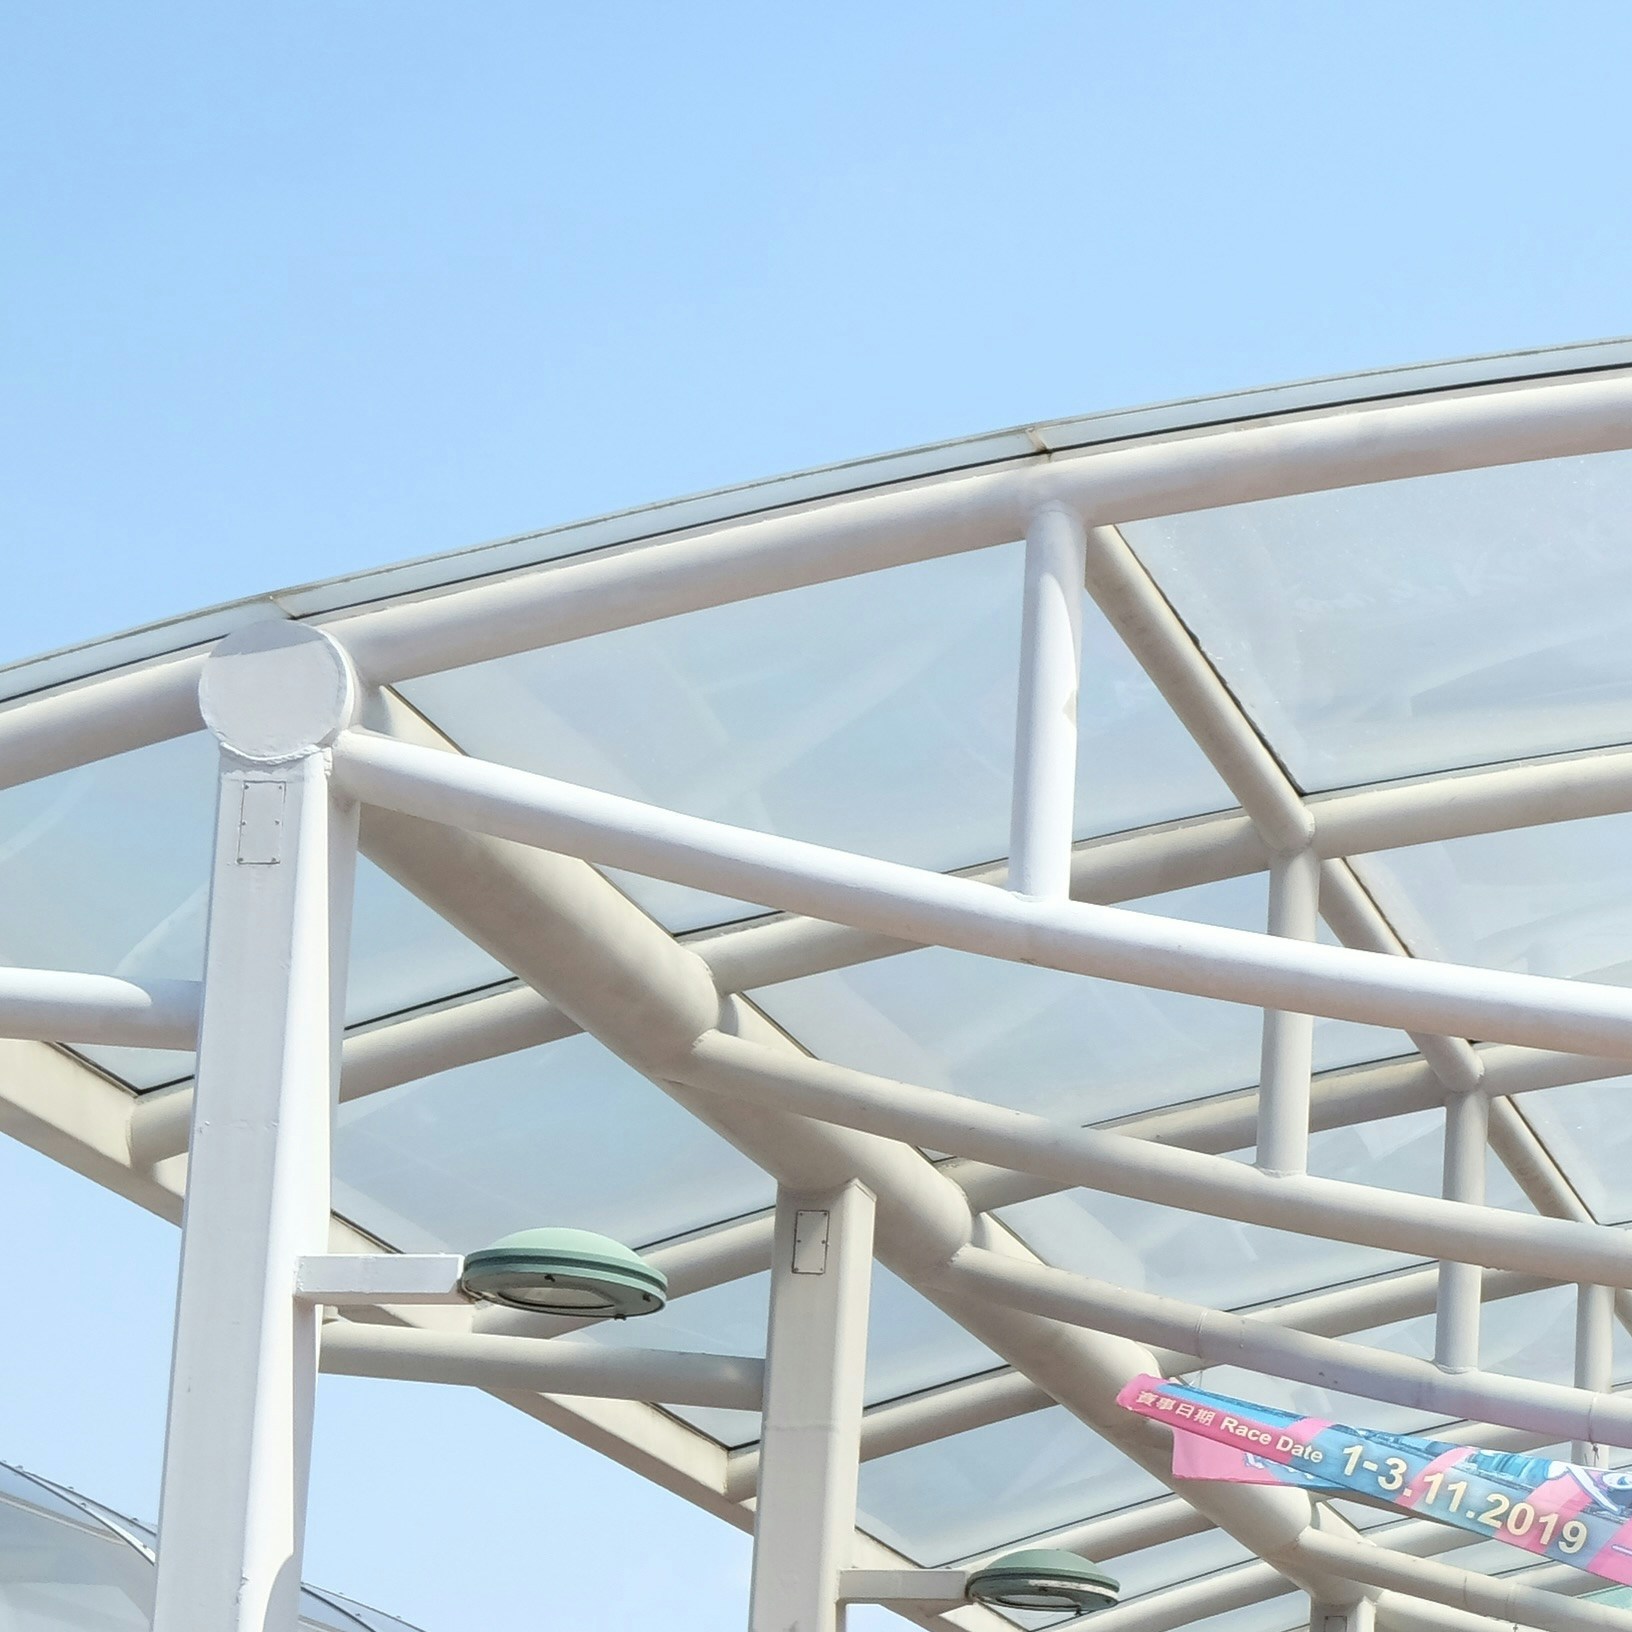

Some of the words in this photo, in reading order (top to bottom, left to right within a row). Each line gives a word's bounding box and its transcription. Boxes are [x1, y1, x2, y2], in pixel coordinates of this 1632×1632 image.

[1137, 1390, 1217, 1427] 賽事日期
[1219, 1415, 1273, 1447] Race
[1276, 1434, 1324, 1465] Date
[1342, 1445, 1588, 1554] 1-3.11.2019
